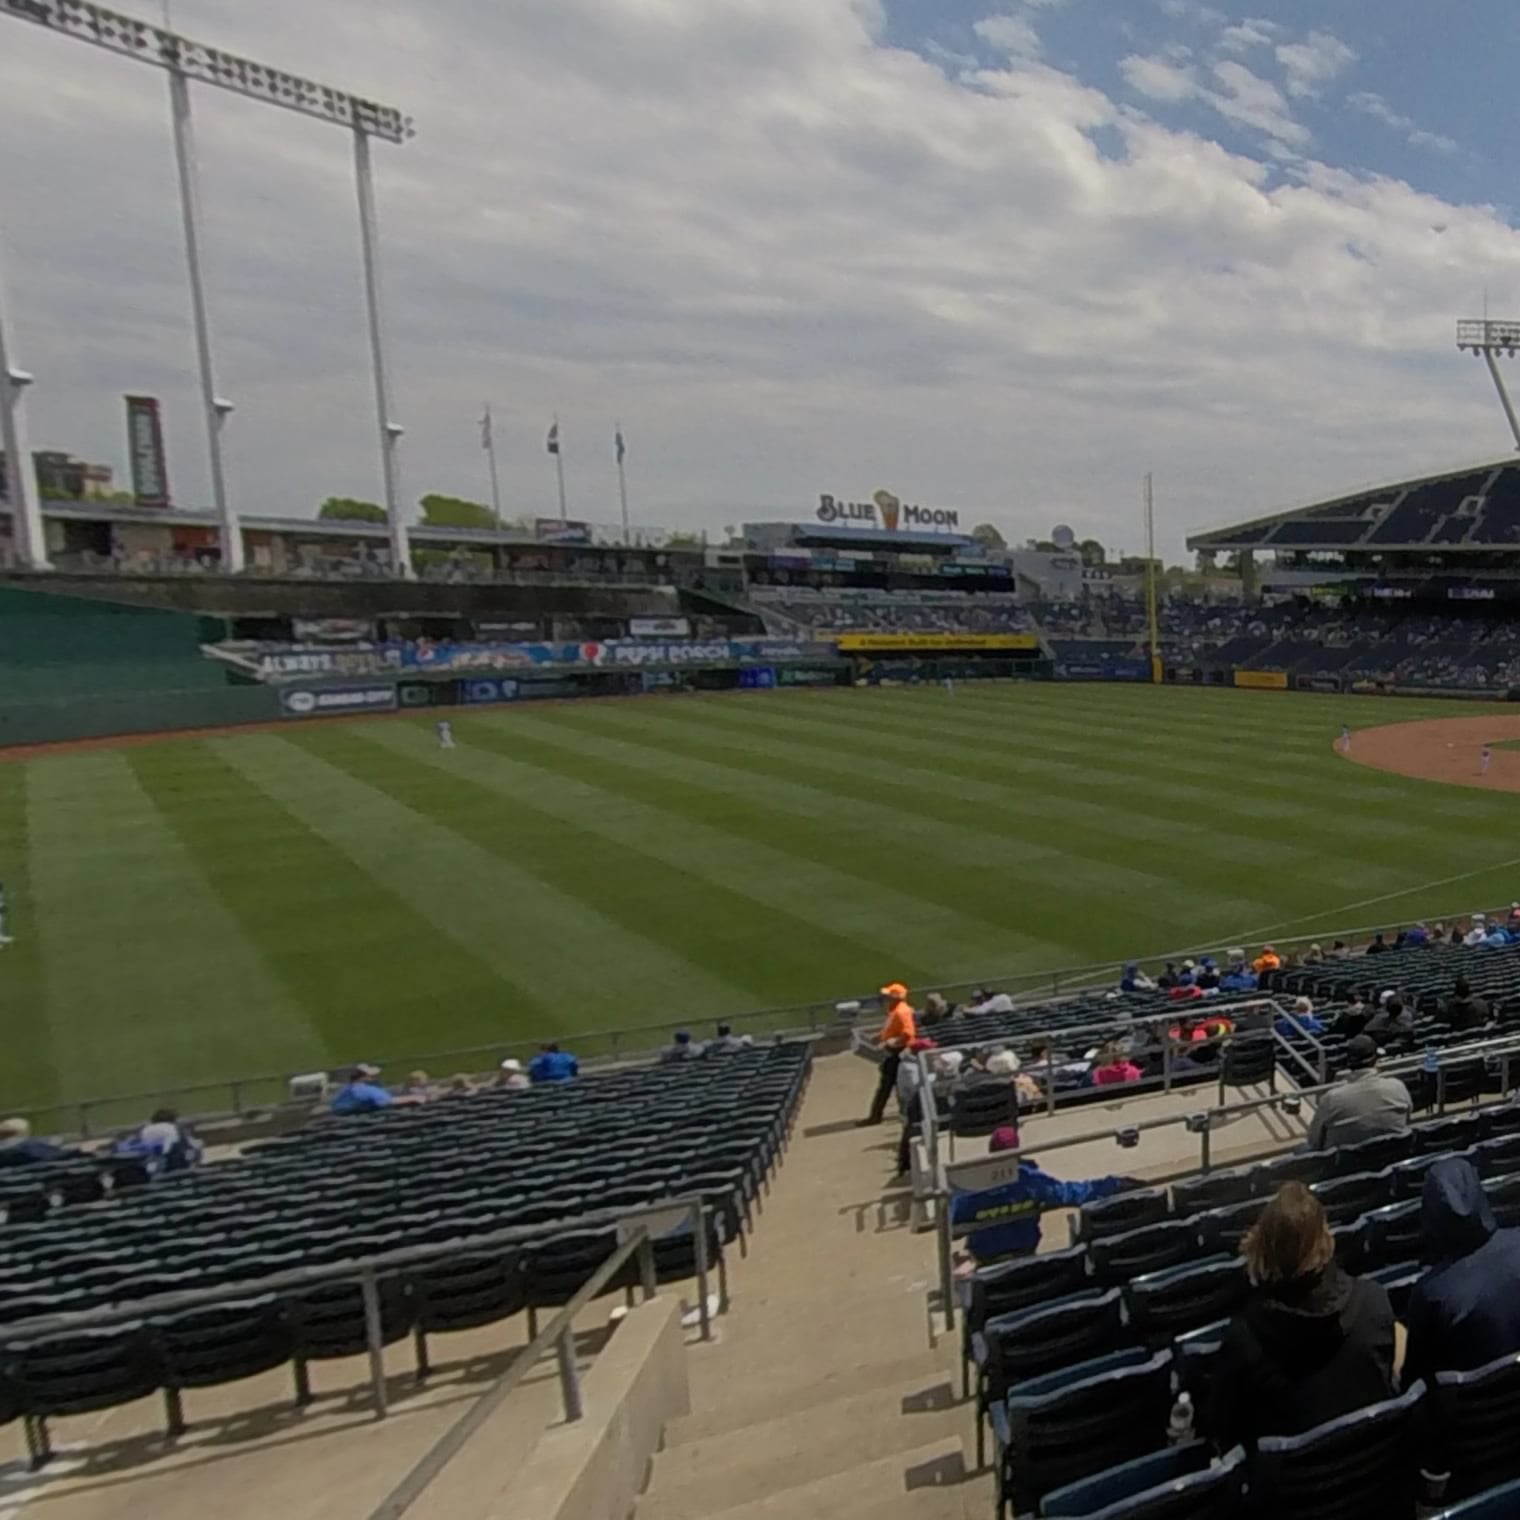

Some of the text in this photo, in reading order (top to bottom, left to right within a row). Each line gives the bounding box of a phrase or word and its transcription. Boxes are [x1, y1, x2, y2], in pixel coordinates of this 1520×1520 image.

[816, 494, 959, 526] BLUE MOON
[263, 653, 331, 673] ALWAYS
[616, 646, 730, 662] PEPSI PORCH
